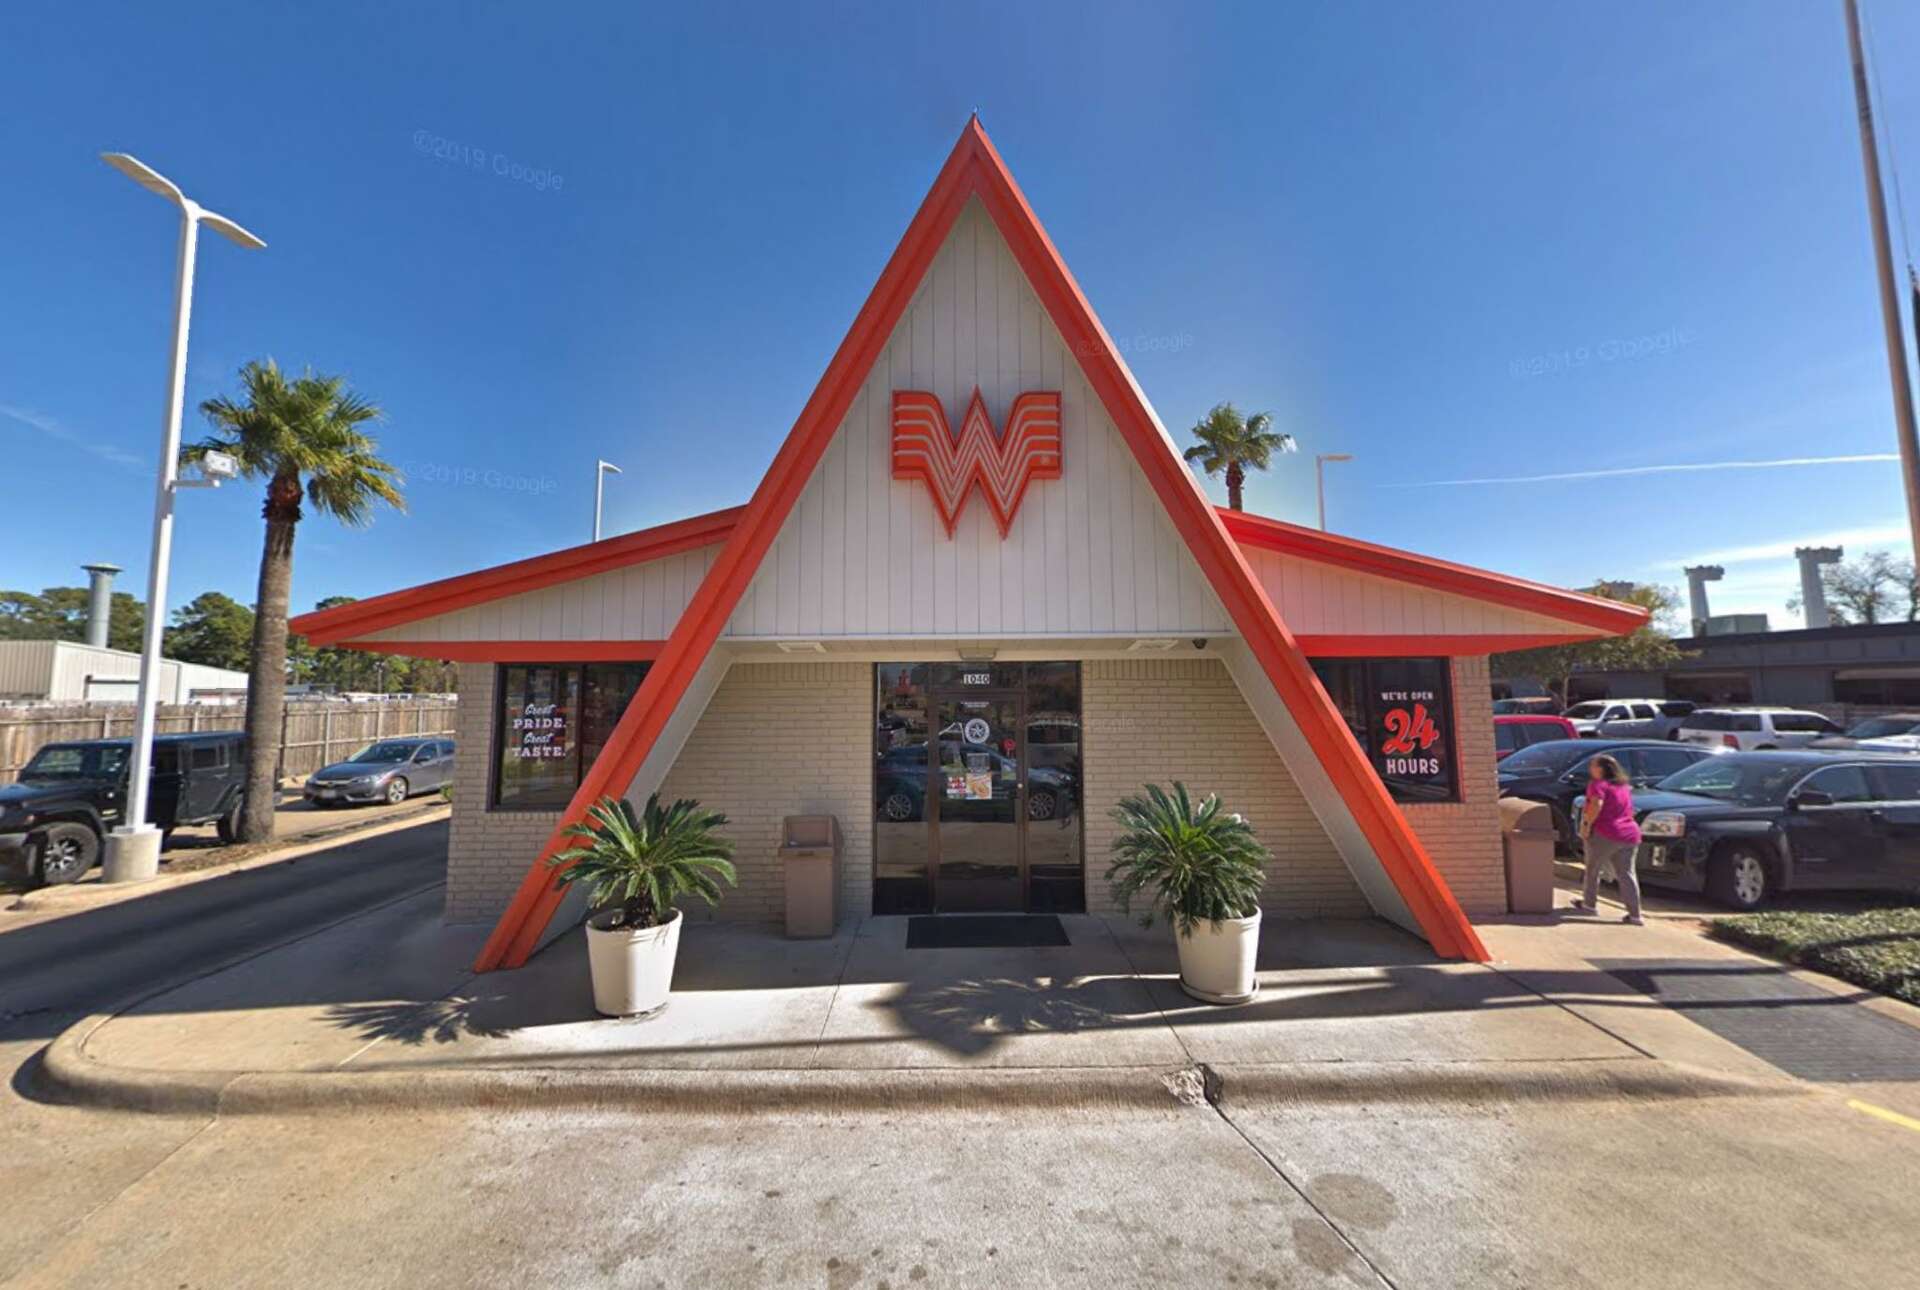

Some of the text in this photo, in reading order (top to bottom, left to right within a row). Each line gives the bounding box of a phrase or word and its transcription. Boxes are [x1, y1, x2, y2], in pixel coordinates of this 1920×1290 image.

[963, 673, 990, 685] 1040
[1410, 691, 1434, 701] OPEN
[512, 718, 567, 730] PRIDE.
[1382, 703, 1440, 755] 24
[511, 747, 566, 757] TASTE.
[1386, 758, 1440, 775] HOURS
